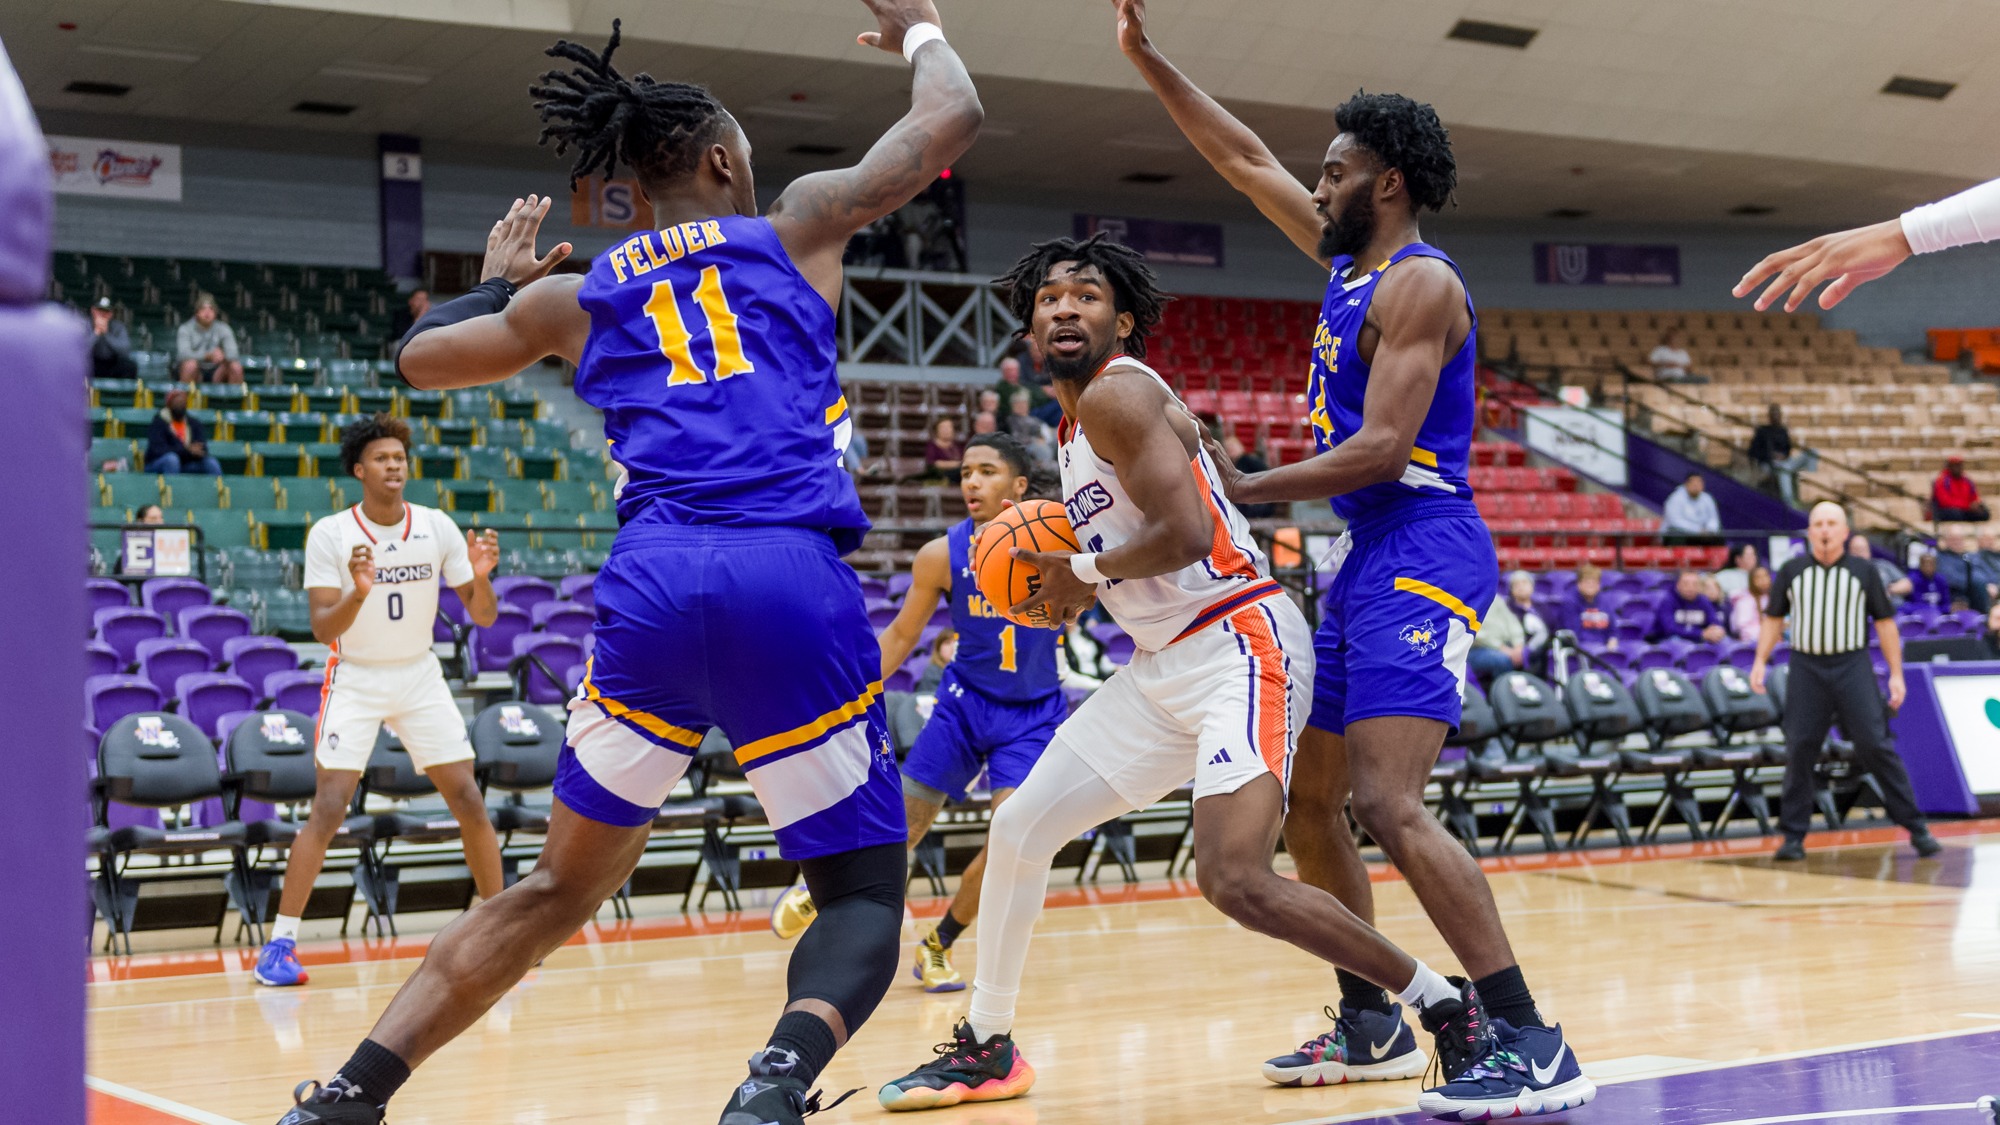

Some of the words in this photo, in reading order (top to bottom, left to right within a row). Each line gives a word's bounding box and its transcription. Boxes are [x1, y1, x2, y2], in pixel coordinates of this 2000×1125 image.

[603, 184, 637, 222] S
[609, 219, 727, 284] FELDER
[642, 264, 755, 387] 11
[127, 536, 153, 569] E
[387, 592, 403, 621] 0
[999, 624, 1017, 673] 1
[1412, 629, 1432, 644] M
